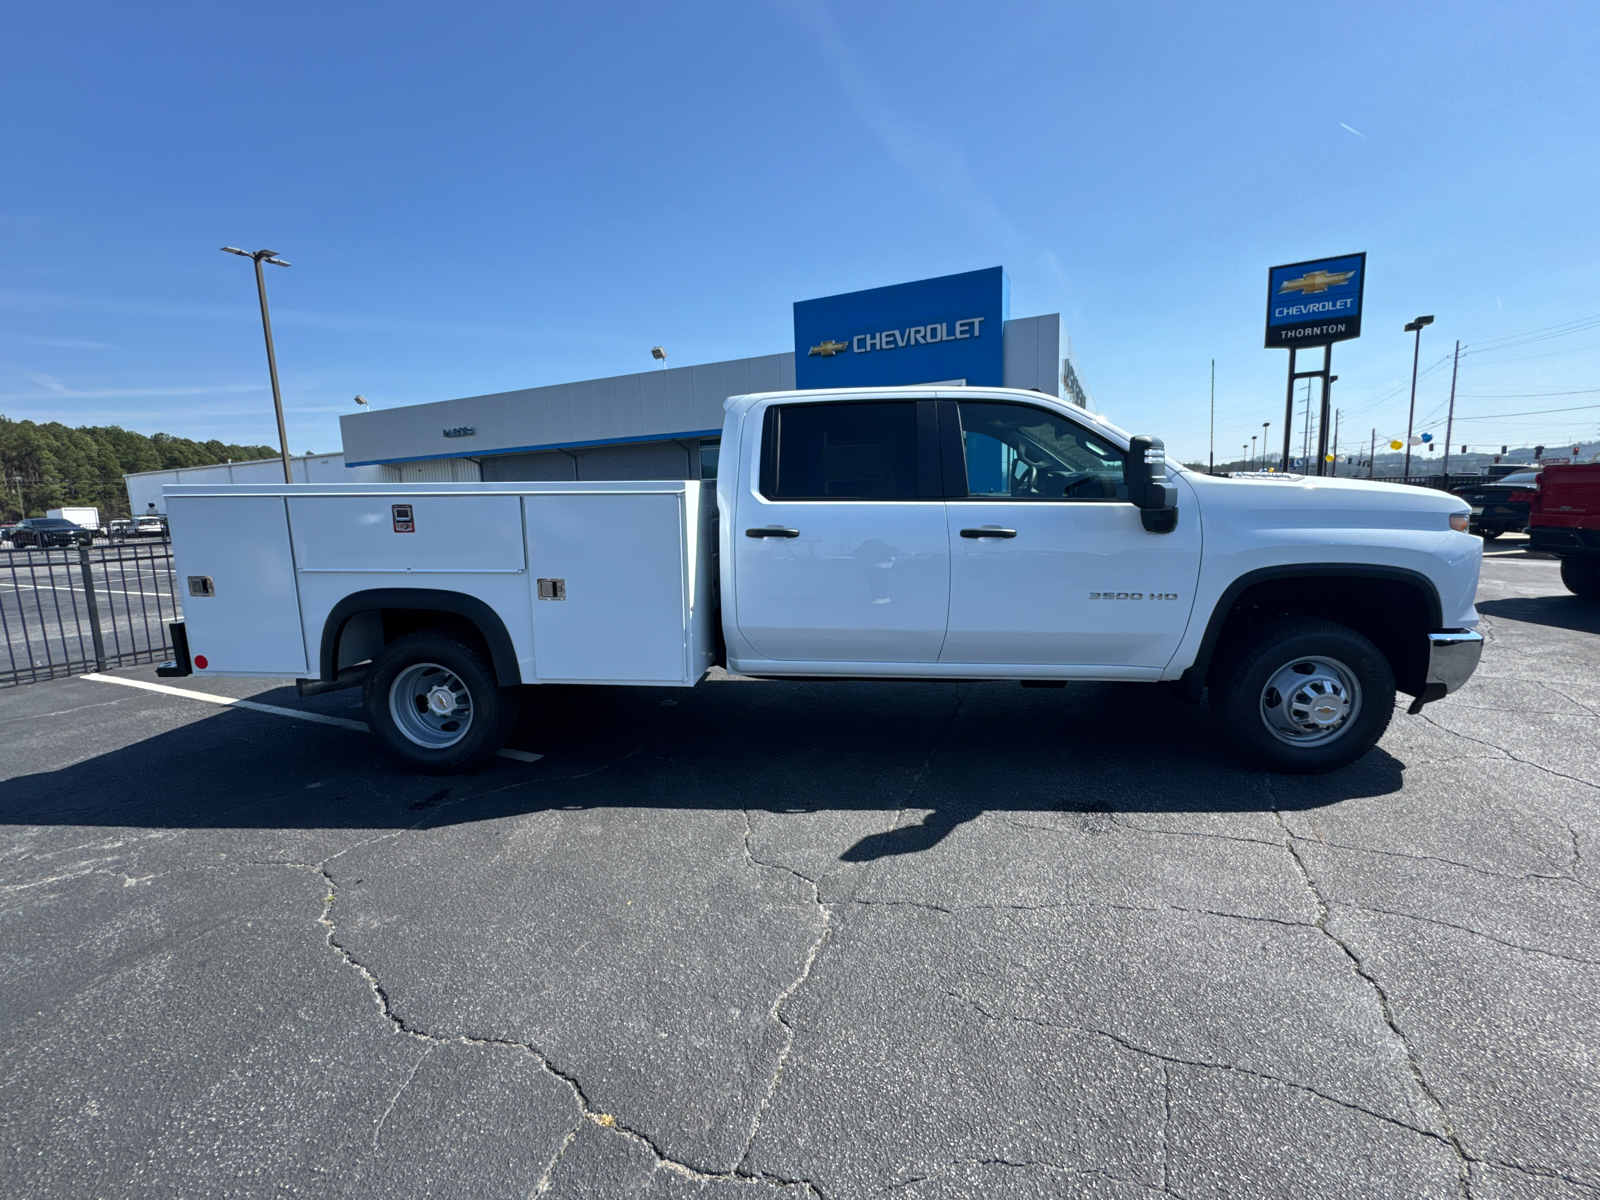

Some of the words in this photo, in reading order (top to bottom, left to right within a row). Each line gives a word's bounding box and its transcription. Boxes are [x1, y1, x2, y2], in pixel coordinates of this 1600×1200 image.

[1275, 298, 1353, 317] CHEVROLET
[853, 317, 984, 353] CHEVROLET
[1281, 323, 1346, 339] THORNTON
[1089, 592, 1143, 600] 3500
[1149, 593, 1178, 601] HD
